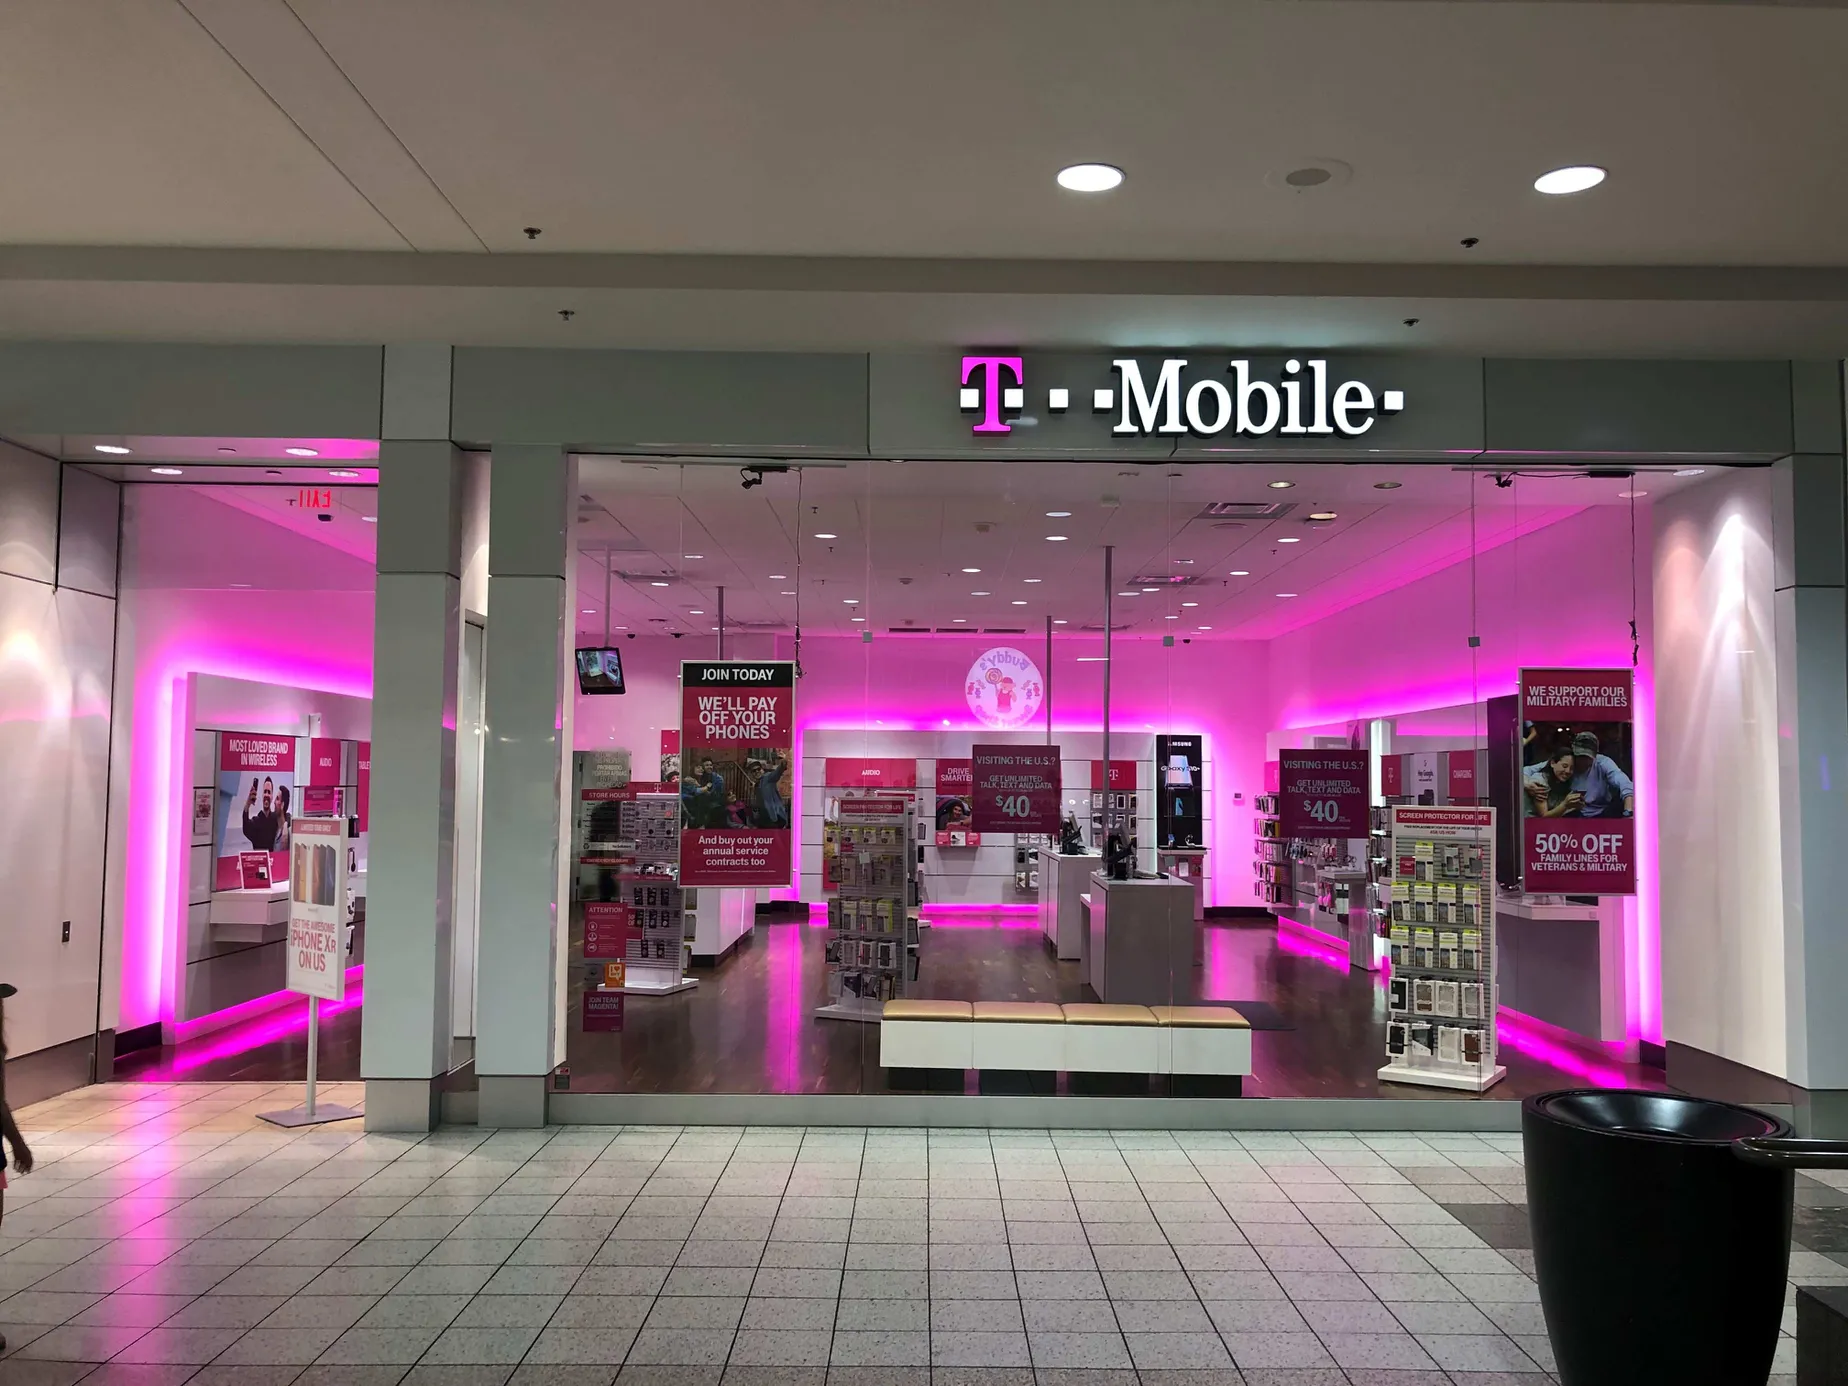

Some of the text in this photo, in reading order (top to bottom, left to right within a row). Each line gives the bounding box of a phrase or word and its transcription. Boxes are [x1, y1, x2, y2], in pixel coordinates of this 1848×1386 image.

[701, 668, 775, 681] JOIN TODAY
[1529, 686, 1625, 697] WE SUPPORT OUR
[698, 696, 777, 711] WE'LL PAY
[1526, 696, 1628, 707] MILITARY FAMILIES
[699, 711, 776, 725] OFF YOUR
[705, 725, 770, 739] PHONES
[229, 739, 288, 754] MOST LOVED BRAND
[241, 753, 277, 766] IN WIRELESS
[319, 757, 332, 767] AUDIO
[976, 755, 1056, 766] VISITING THE U.S.?
[1283, 760, 1364, 770] VISITING THE U.S.?
[947, 767, 969, 775] DRIVE
[1296, 779, 1312, 787] GET
[1287, 786, 1307, 794] TALK,
[995, 794, 1030, 818] $40
[1303, 799, 1339, 823] $40
[698, 835, 774, 847] And buy out your
[1535, 833, 1623, 854] 50% OFF
[703, 846, 769, 855] annual service
[706, 857, 766, 866] contracts too
[1540, 854, 1618, 863] FAMILY LINES FOR
[1531, 862, 1628, 872] VETERANS & MILITARY
[311, 921, 335, 933] AWESOME
[291, 929, 322, 951] iPHONE
[299, 950, 326, 972] ON US
